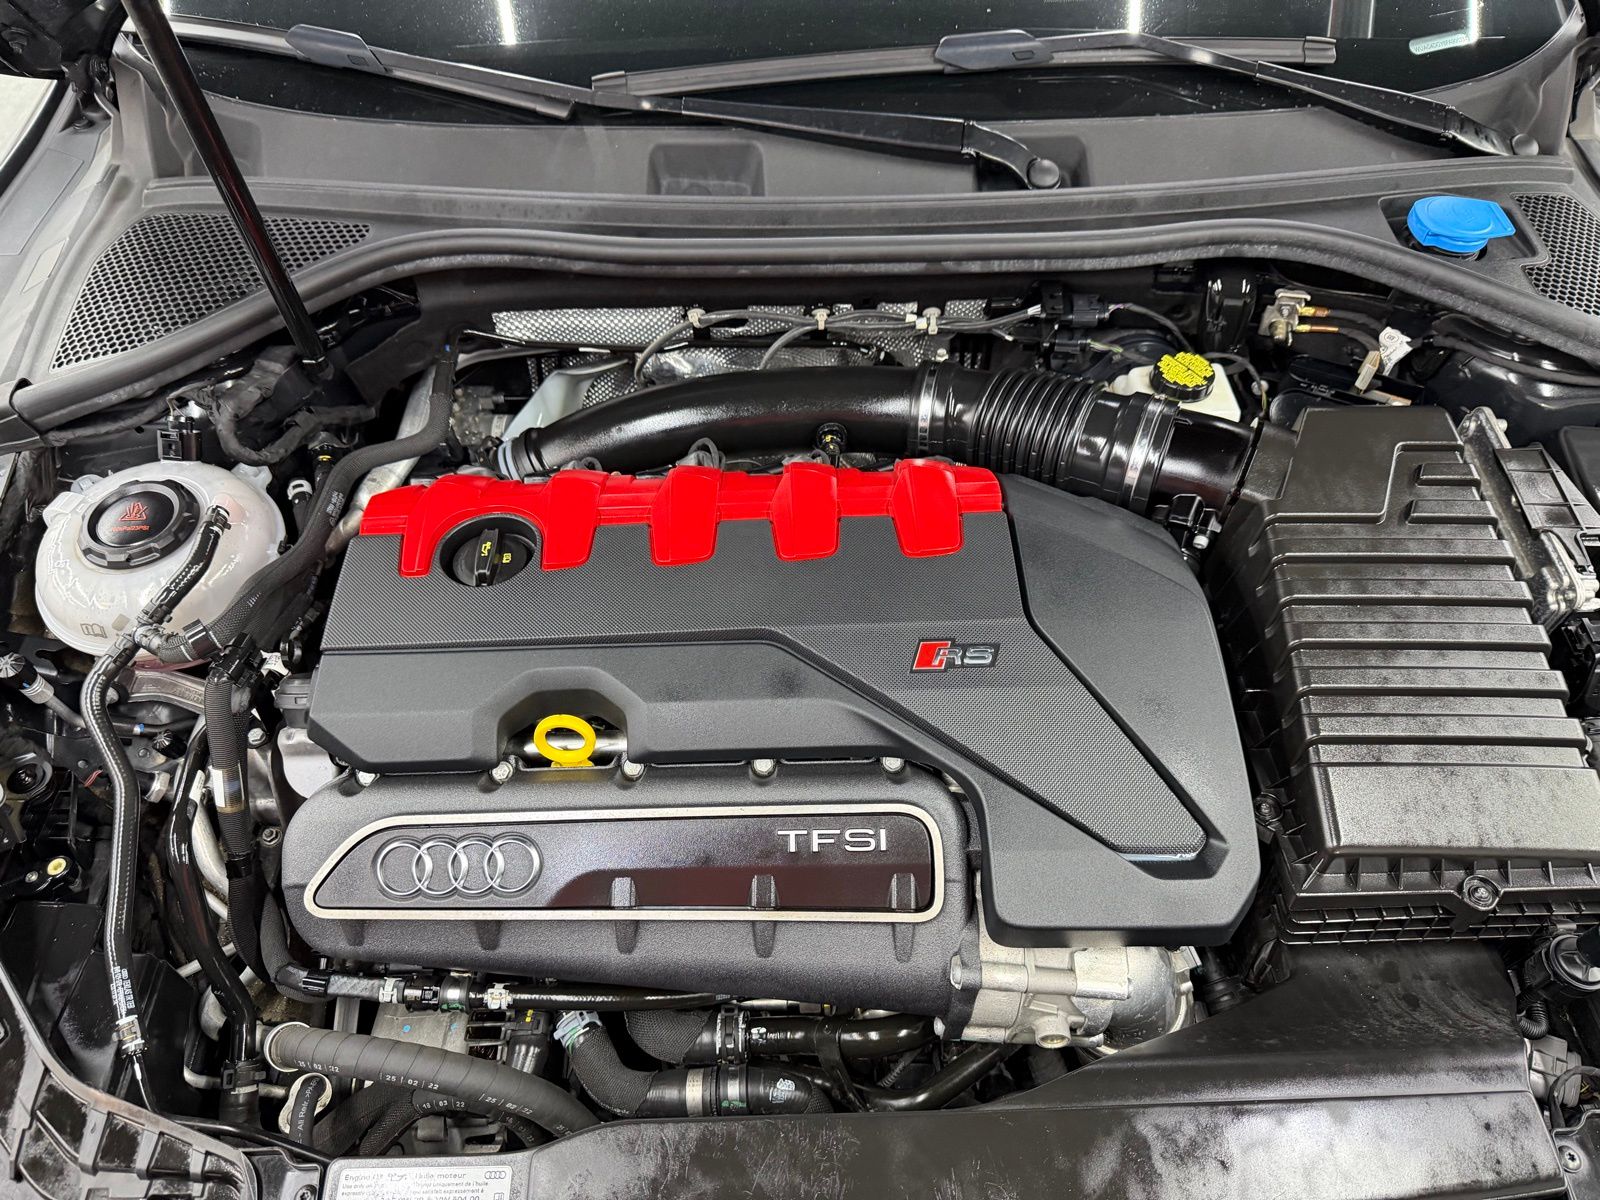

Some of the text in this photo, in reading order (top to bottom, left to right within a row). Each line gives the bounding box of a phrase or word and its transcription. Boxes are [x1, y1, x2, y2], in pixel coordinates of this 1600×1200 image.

[920, 643, 996, 668] RS
[777, 828, 887, 853] TFSI
[385, 1074, 439, 1090] 25 02 22
[455, 1101, 465, 1109] 22
[485, 1096, 533, 1115] 25 02 22
